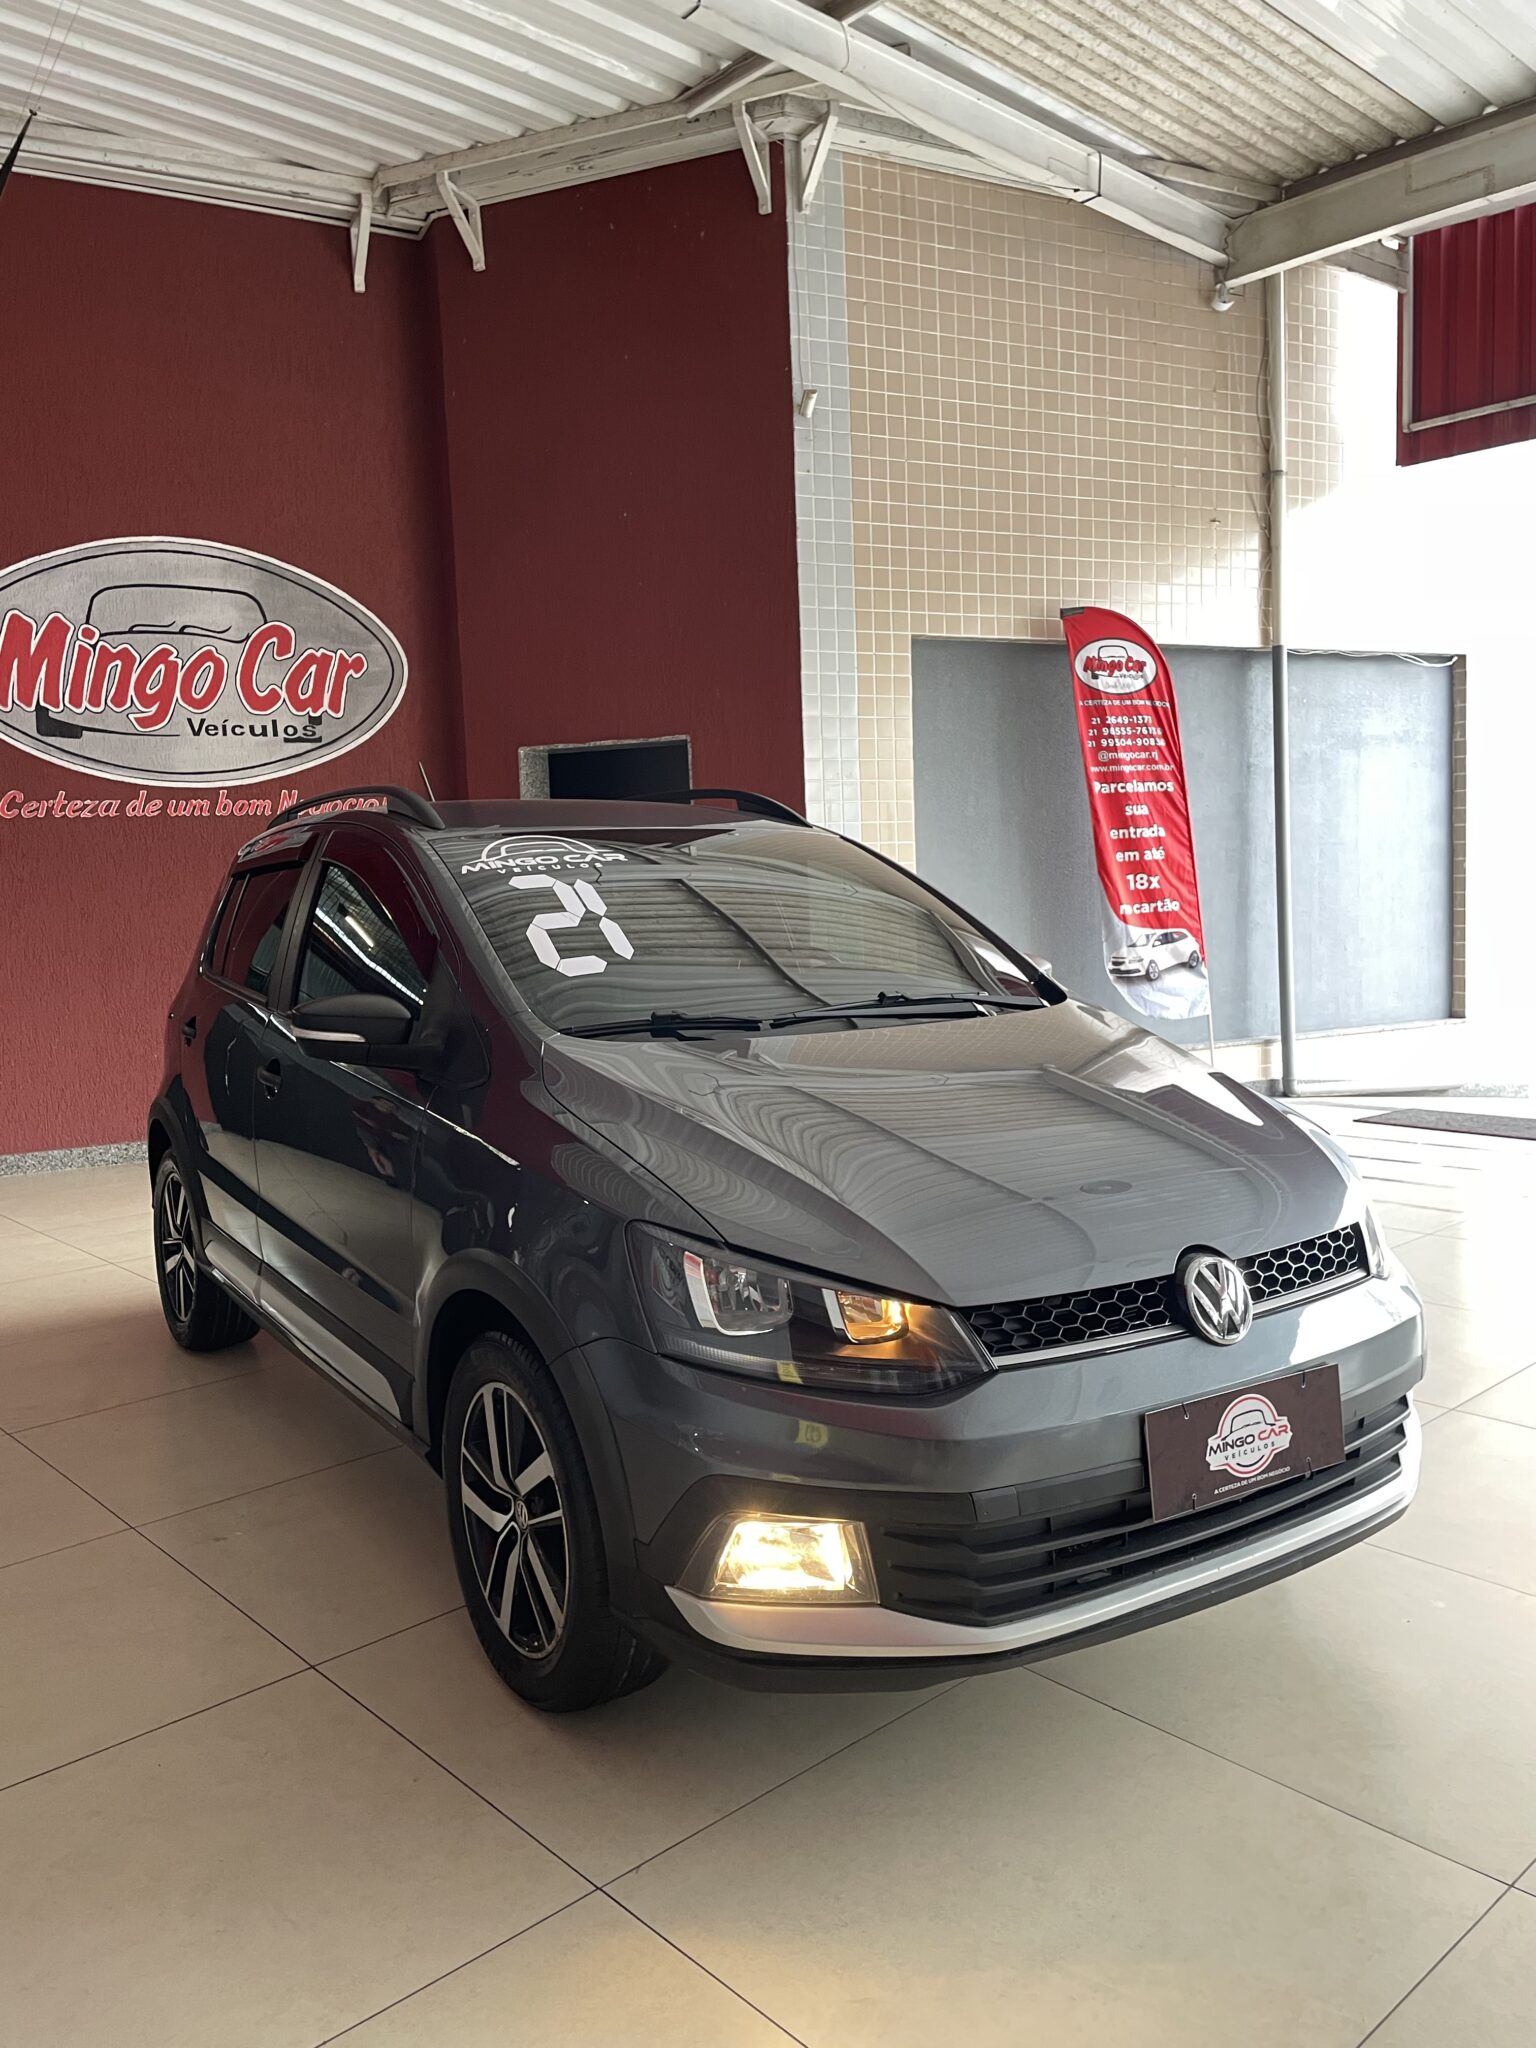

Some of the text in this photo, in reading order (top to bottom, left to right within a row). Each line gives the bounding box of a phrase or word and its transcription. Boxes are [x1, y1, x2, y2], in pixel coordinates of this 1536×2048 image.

[0, 609, 368, 732] Mingo Car
[1083, 656, 1146, 677] Mingo Car
[187, 716, 317, 738] Veículos
[1091, 715, 1152, 725] 21 2649-1371
[1098, 750, 1159, 762] @mingocar.rj
[1093, 780, 1175, 794] Parcelamos
[0, 789, 120, 819] Certeza
[126, 789, 163, 817] de
[166, 798, 211, 817] um
[215, 789, 272, 817] bom
[1125, 804, 1149, 816] sua
[1110, 824, 1166, 839] entrada
[1115, 847, 1165, 862] em até
[461, 853, 628, 875] MINGO CAR
[1126, 874, 1160, 890] 18x
[1132, 898, 1180, 914] cartão
[508, 874, 634, 977] 21
[1209, 1424, 1289, 1457] MINGO CAR
